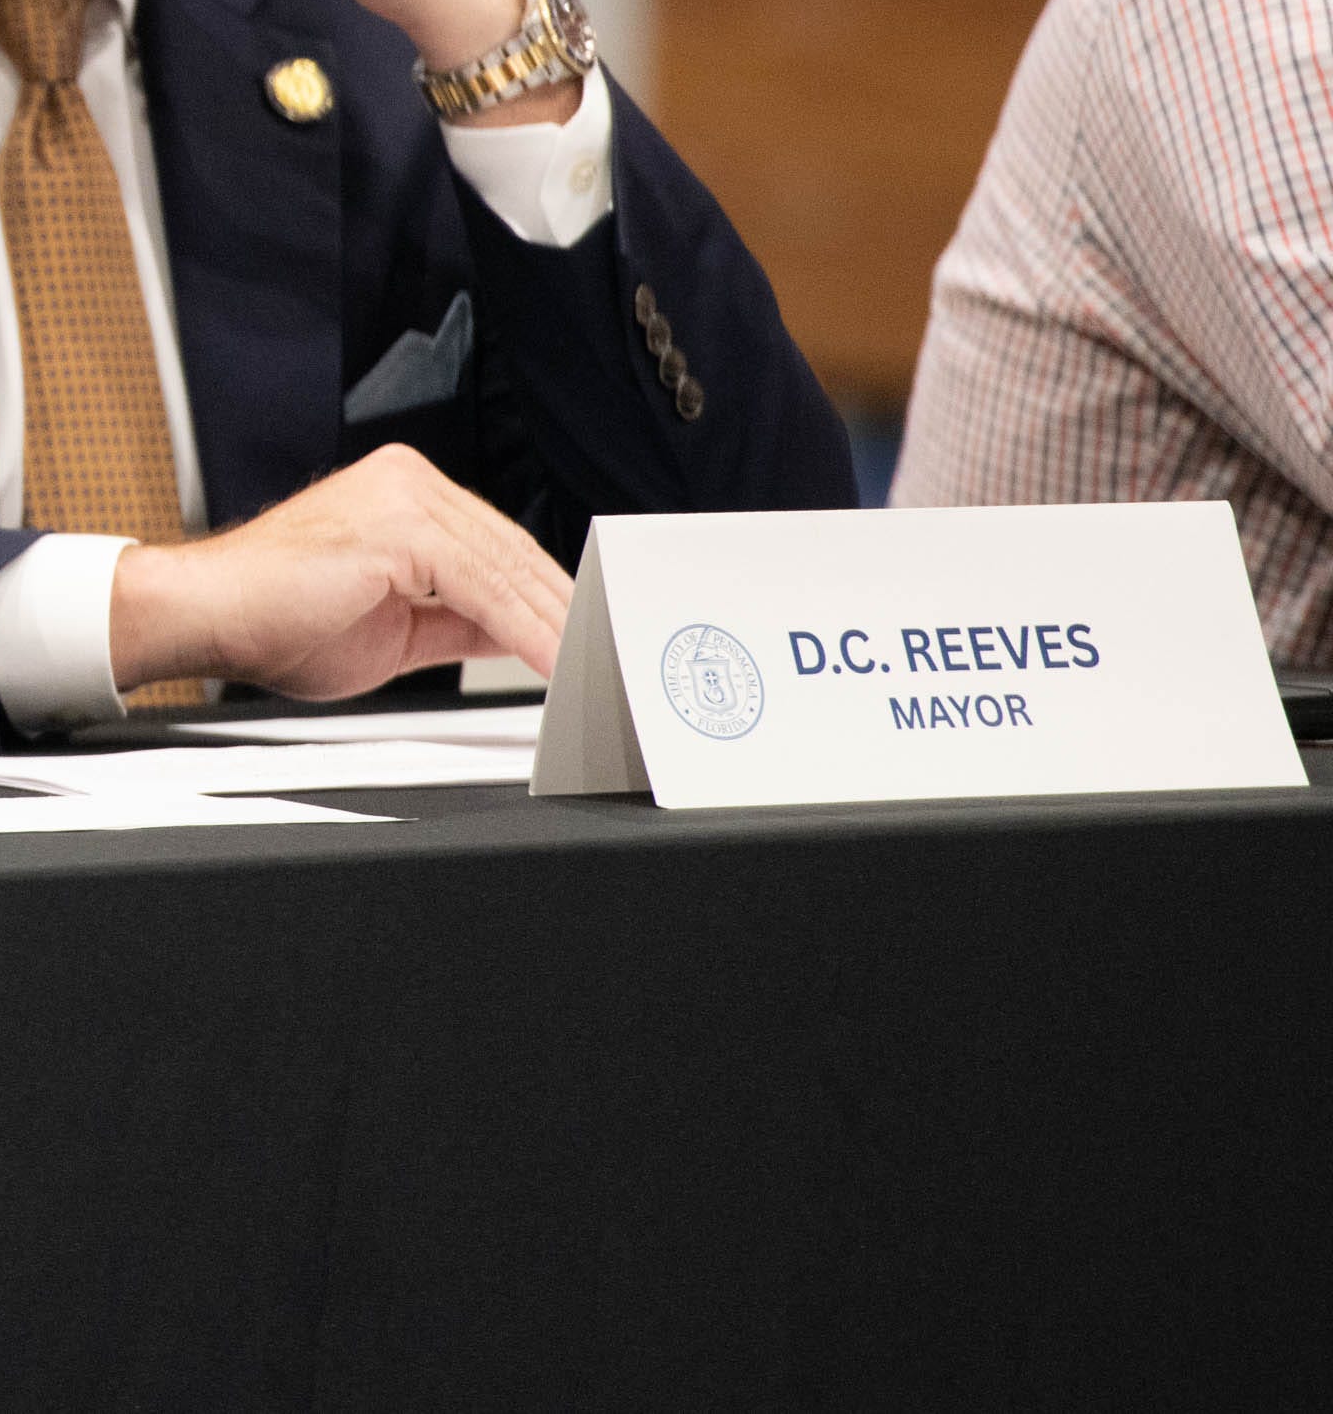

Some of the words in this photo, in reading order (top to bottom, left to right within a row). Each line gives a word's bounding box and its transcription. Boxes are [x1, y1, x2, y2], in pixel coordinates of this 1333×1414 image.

[789, 630, 890, 675] D.C.
[901, 624, 1099, 672] REEVES
[889, 694, 1033, 729] MAYOR
